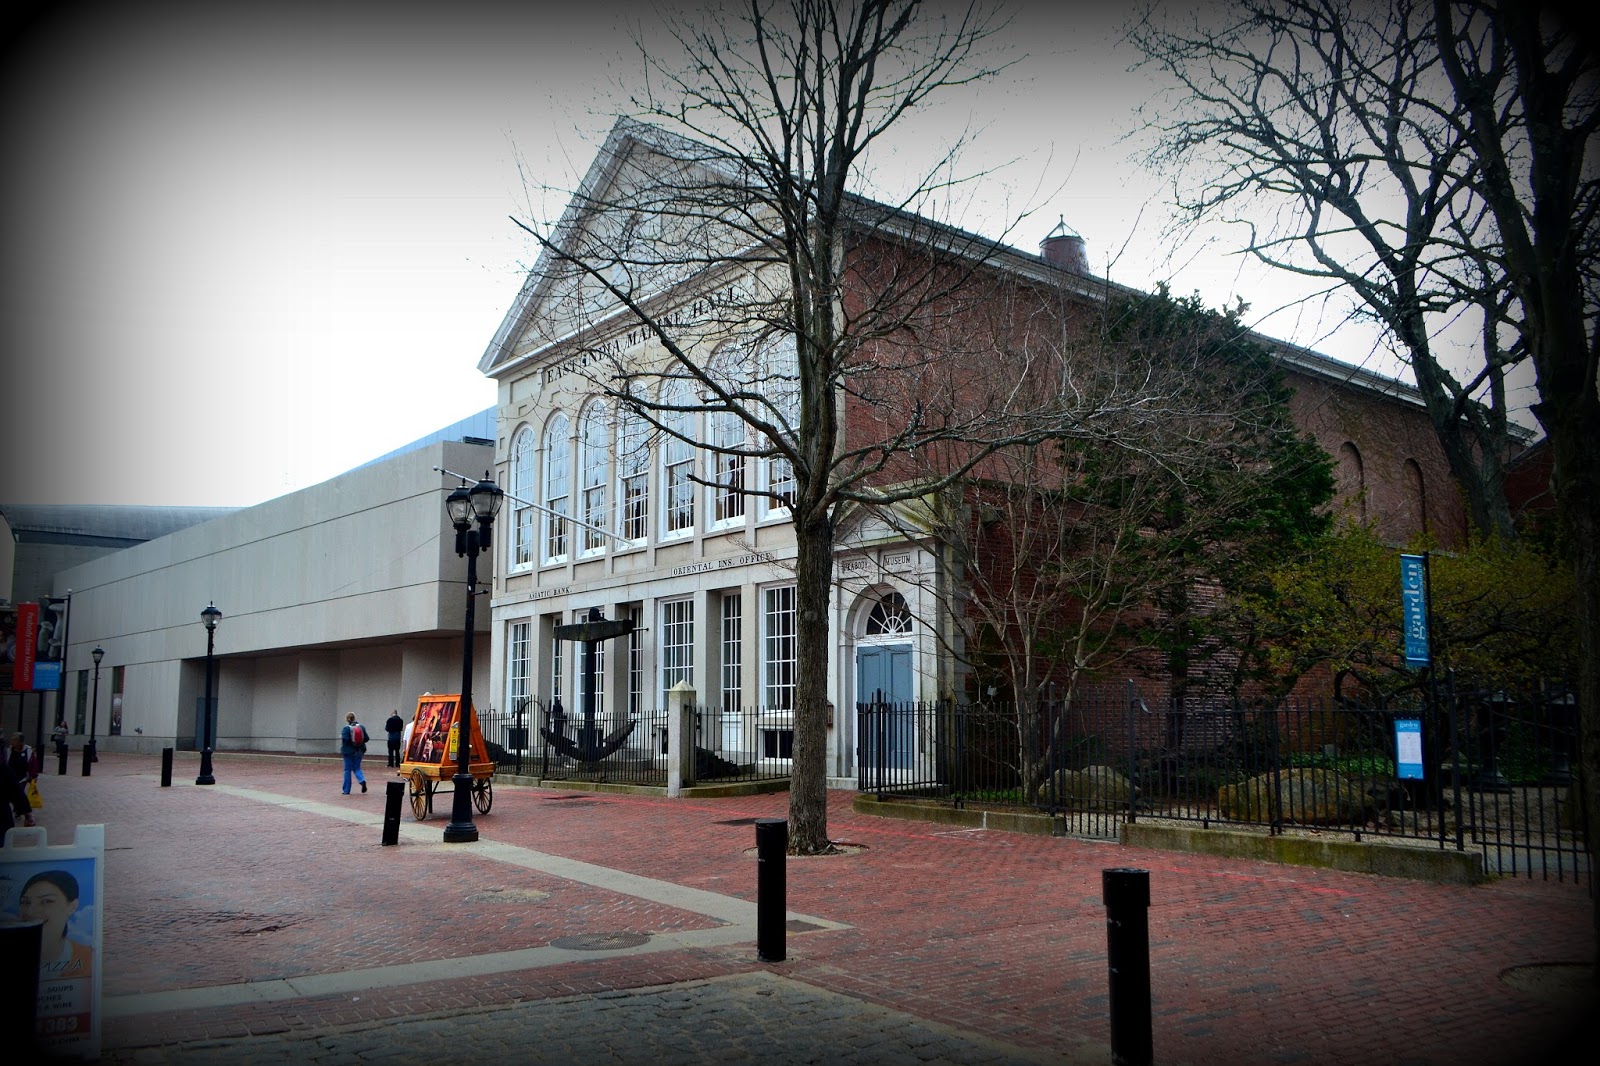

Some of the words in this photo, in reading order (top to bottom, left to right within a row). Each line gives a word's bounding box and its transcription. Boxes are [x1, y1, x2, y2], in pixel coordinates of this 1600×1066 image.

[547, 359, 576, 383] EAST
[673, 562, 714, 576] ORIENTAL
[718, 558, 735, 568] INS.
[884, 554, 911, 567] MUSEUM
[528, 590, 551, 600] ASIATIC
[1404, 563, 1426, 641] garden
[25, 612, 34, 639] Peabody
[24, 638, 33, 656] Essex
[23, 656, 32, 682] Museum
[47, 984, 74, 993] SOUPS
